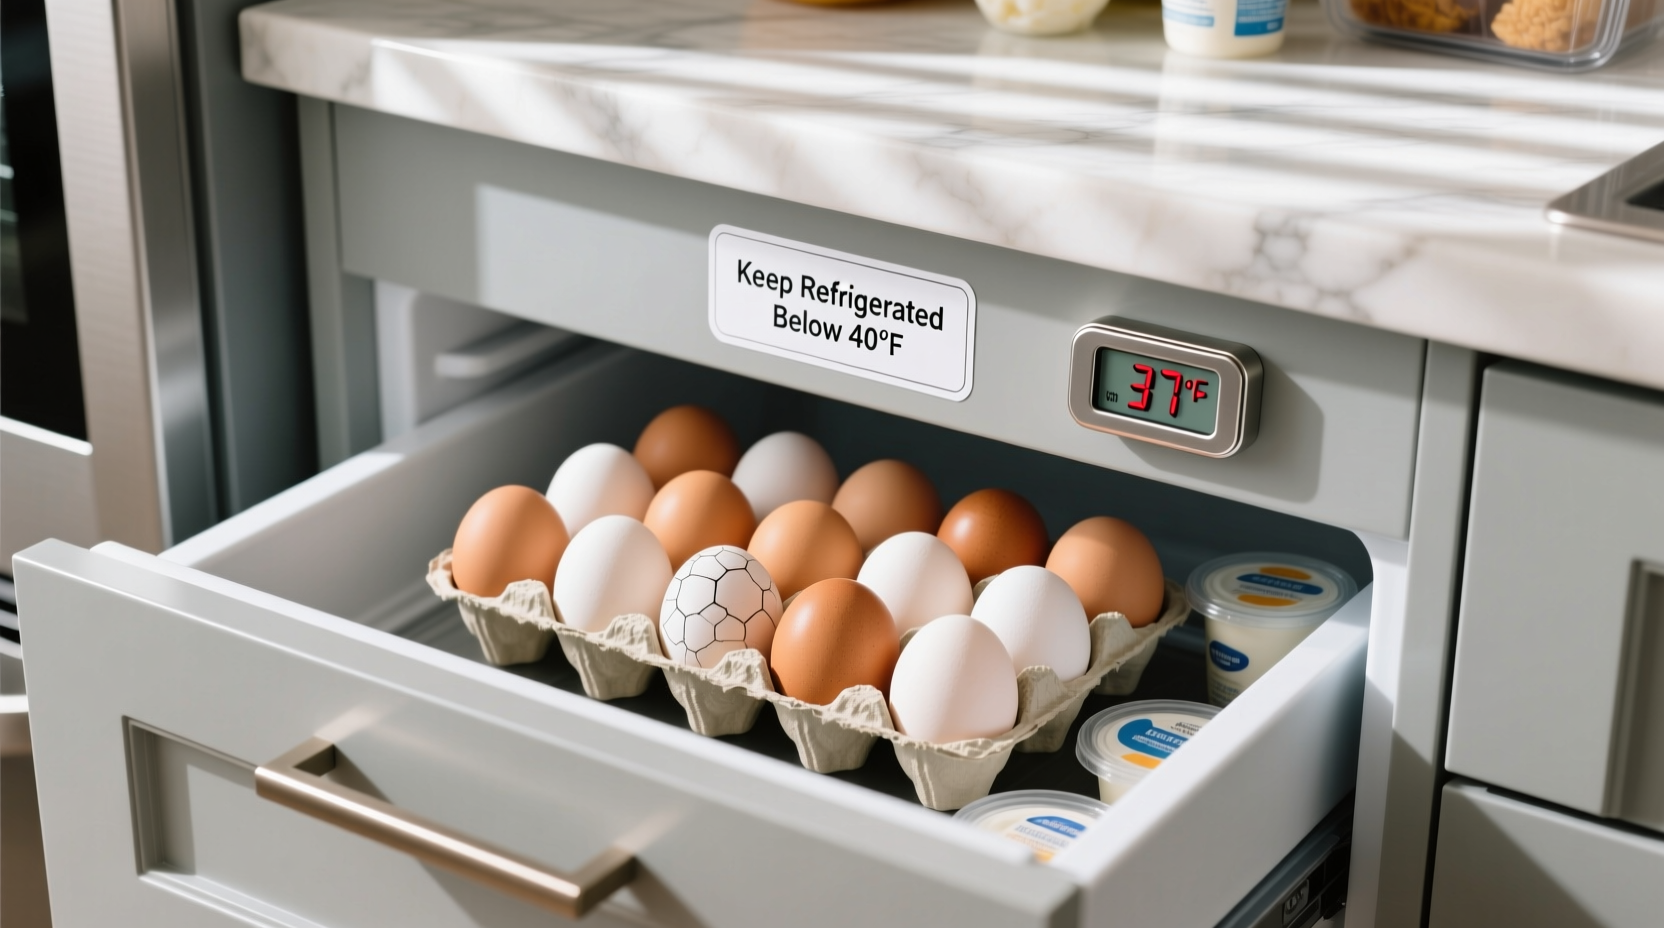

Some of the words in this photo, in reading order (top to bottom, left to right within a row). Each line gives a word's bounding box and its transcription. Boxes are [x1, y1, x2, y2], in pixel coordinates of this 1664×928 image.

[737, 259, 793, 298] Keep
[801, 274, 944, 331] Refrigerated
[773, 304, 843, 342] Below
[848, 324, 904, 356] 40°F
